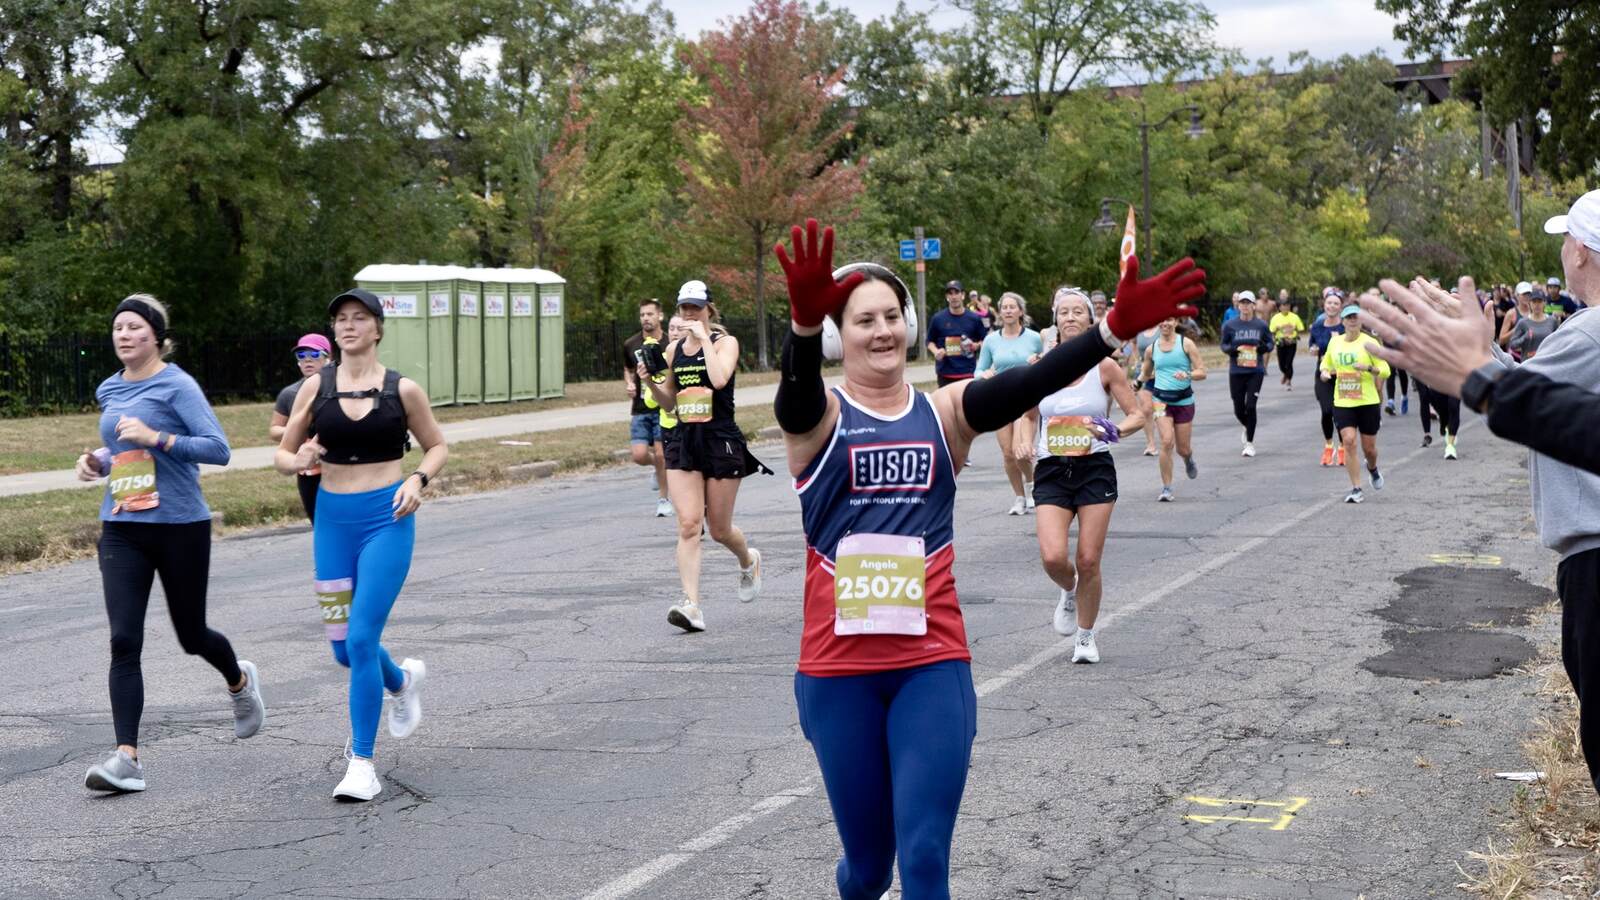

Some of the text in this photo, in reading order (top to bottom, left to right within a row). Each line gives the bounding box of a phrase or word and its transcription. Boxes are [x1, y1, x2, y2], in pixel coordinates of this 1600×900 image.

[1235, 330, 1260, 340] ACADIA
[1048, 436, 1090, 447] 28800
[869, 450, 918, 483] USO
[873, 497, 895, 505] PEOPLE
[860, 559, 898, 571] Angela
[838, 575, 923, 601] 25076
